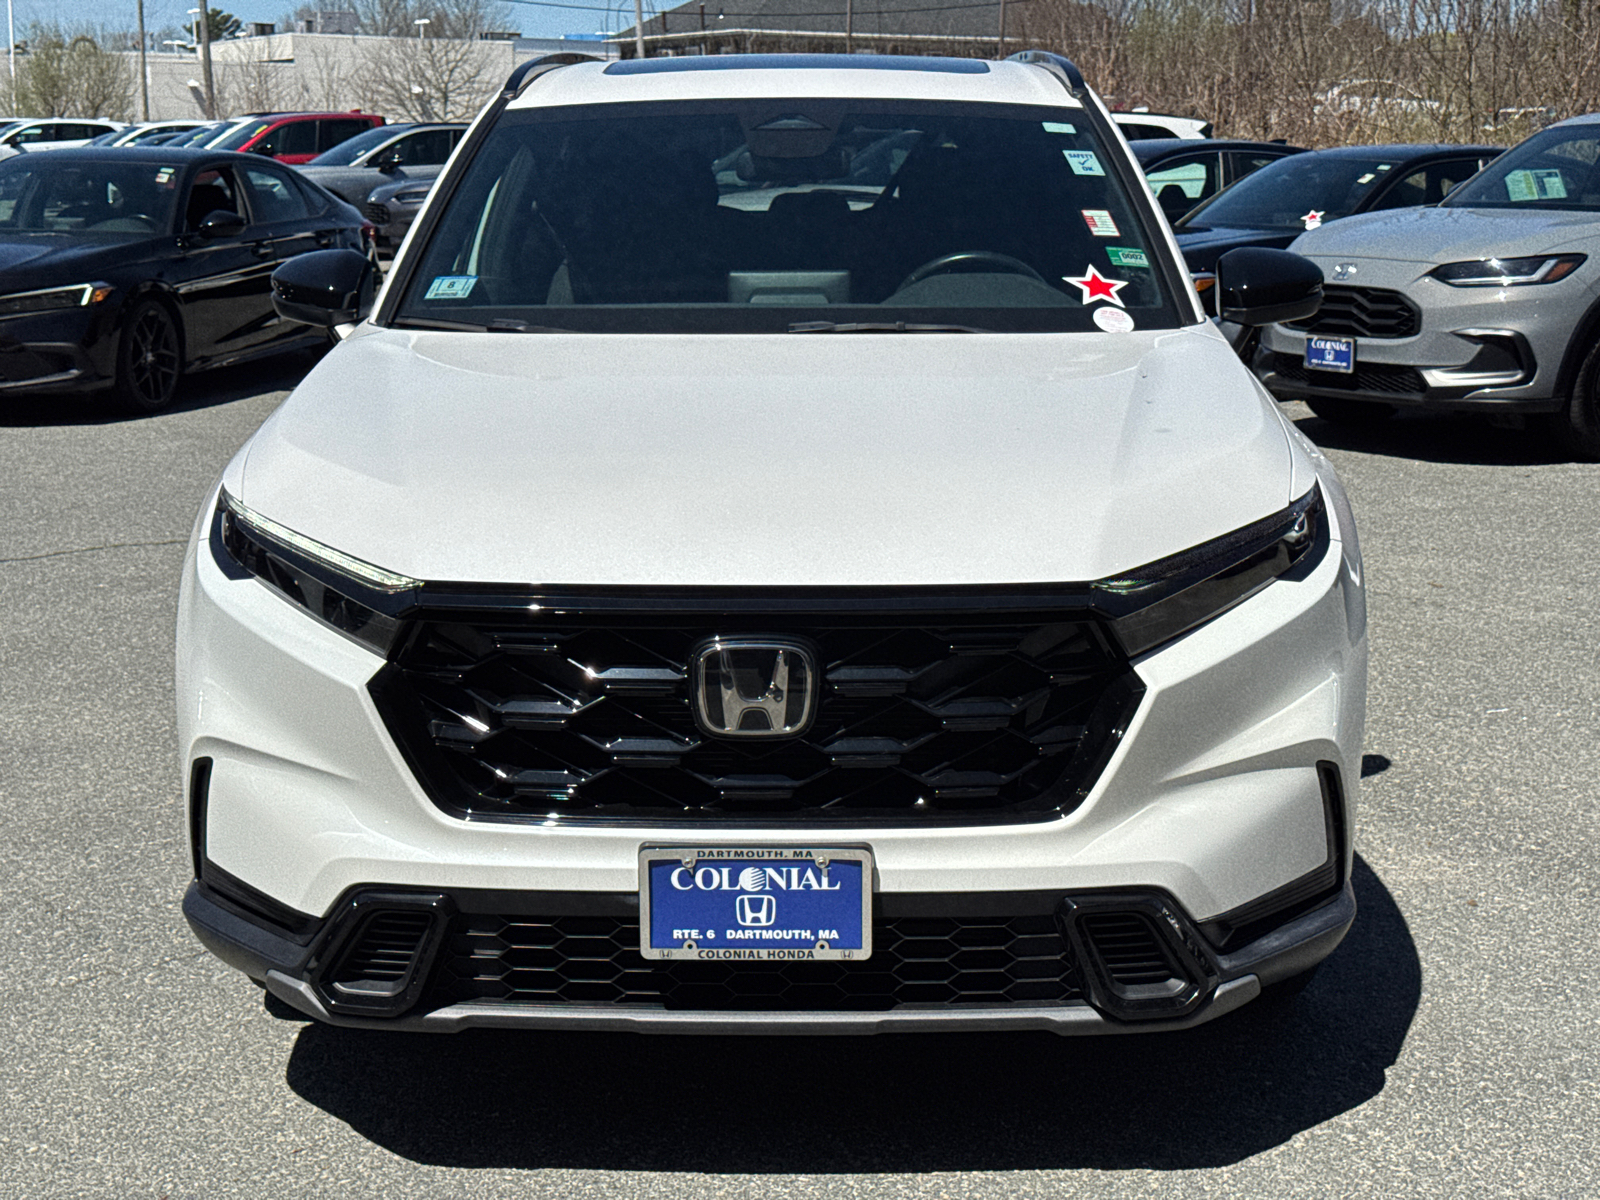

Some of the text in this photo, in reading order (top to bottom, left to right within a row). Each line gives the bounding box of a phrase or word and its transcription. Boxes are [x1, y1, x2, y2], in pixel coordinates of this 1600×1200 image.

[792, 850, 813, 858] MA
[670, 867, 841, 892] COLONIAL
[673, 929, 839, 941] RTE. 6 DARTMOUTH, MA
[698, 950, 815, 959] COLONIAL HONDA
